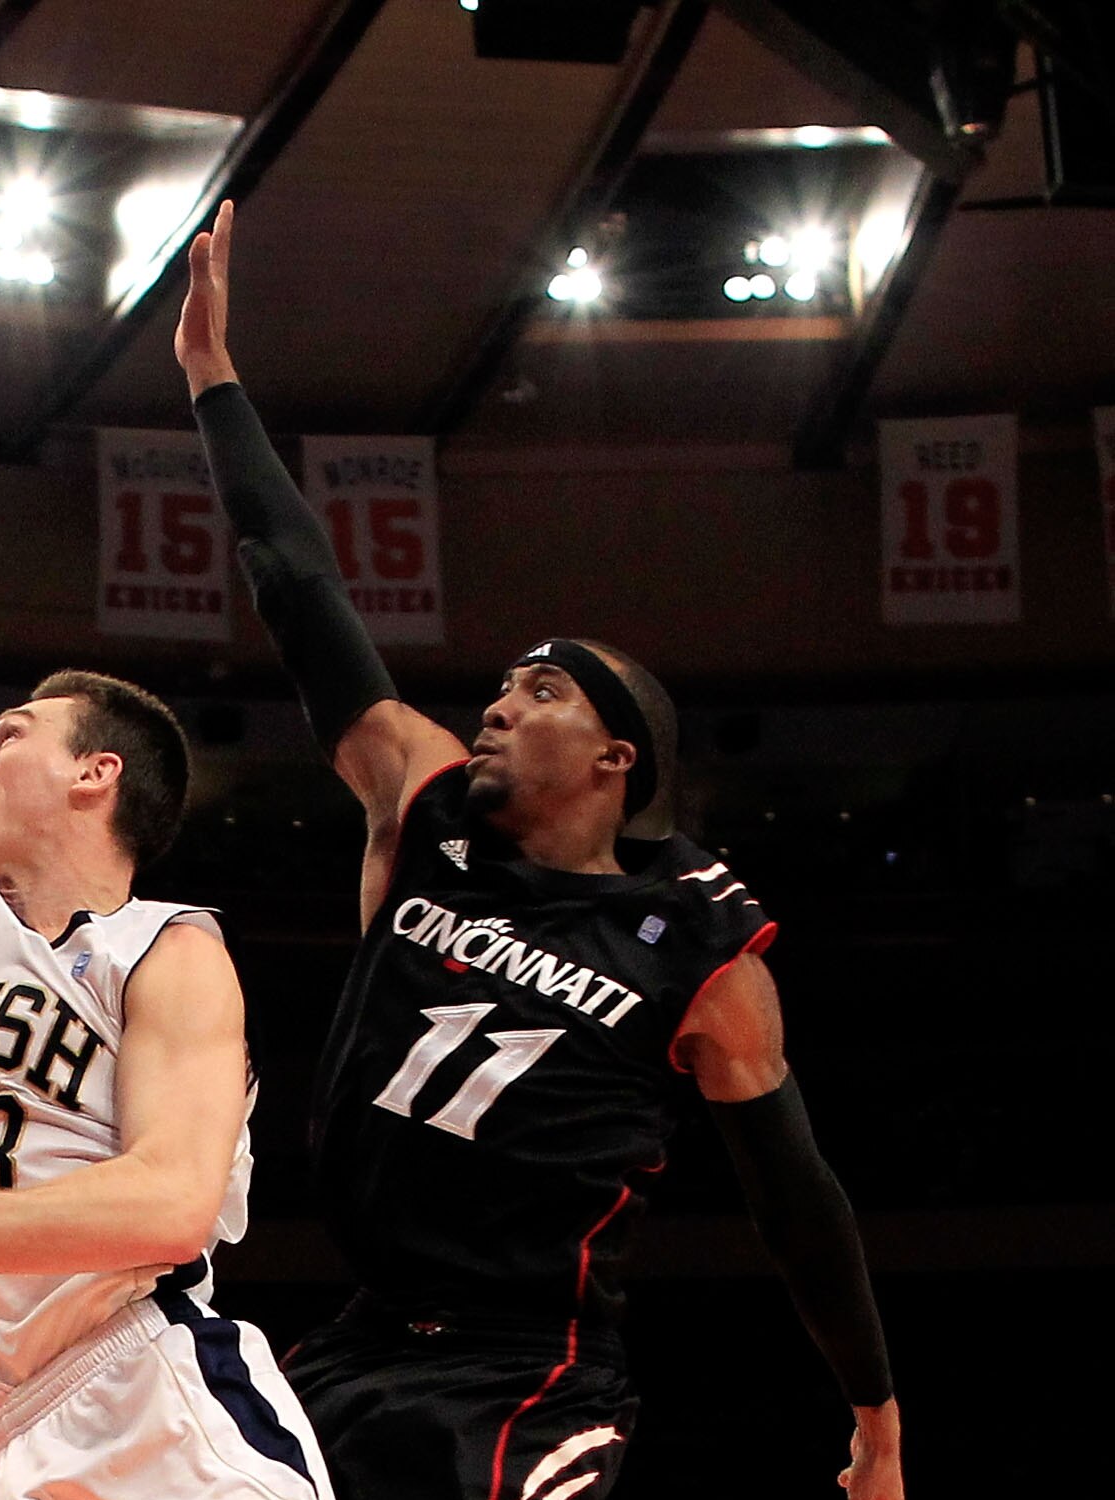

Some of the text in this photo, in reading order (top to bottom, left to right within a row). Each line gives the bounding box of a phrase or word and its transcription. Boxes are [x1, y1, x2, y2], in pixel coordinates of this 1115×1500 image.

[115, 491, 213, 576] 15
[325, 498, 425, 580] 15
[899, 477, 1002, 560] 19
[391, 897, 644, 1029] CINCINNATI
[371, 1002, 568, 1142] 11
